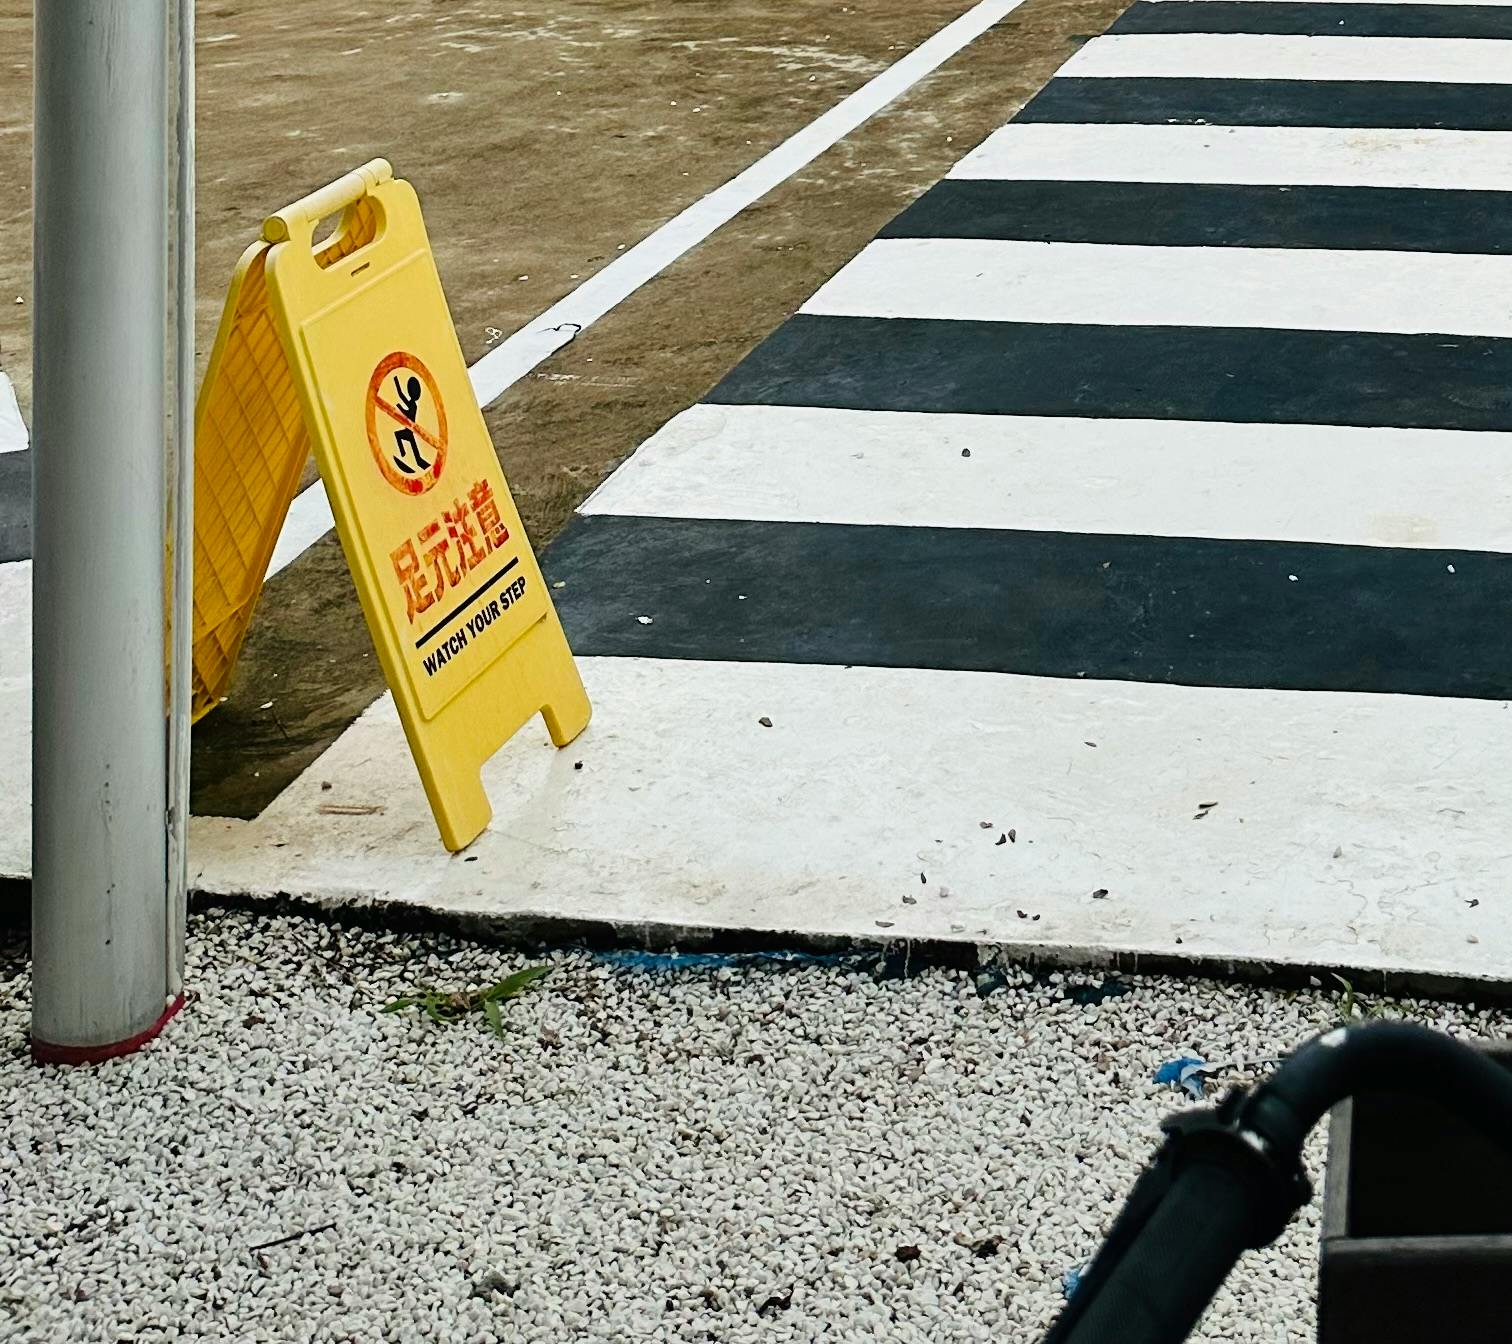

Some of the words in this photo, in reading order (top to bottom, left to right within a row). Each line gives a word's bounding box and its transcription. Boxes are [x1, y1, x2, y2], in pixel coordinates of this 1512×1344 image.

[389, 479, 510, 624] 足元注意
[422, 628, 468, 677] WATCH
[465, 600, 501, 639] YOUR
[499, 575, 526, 611] STEP
